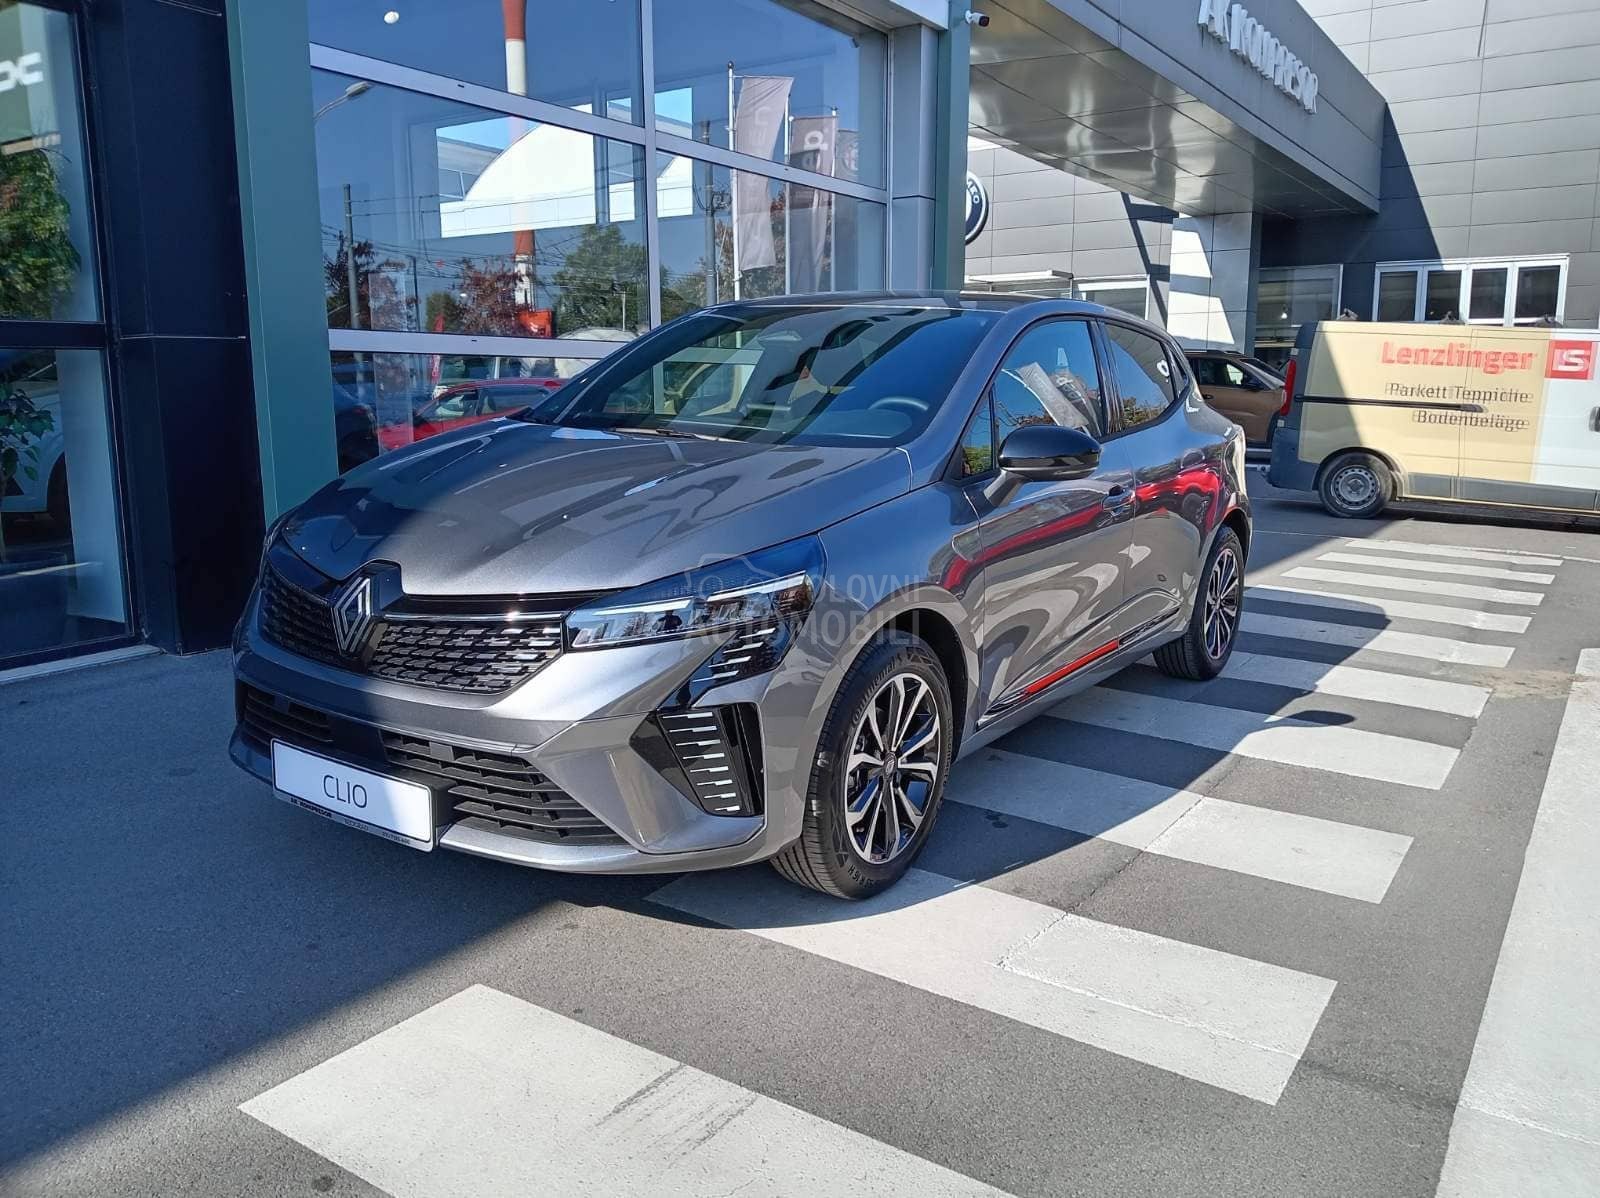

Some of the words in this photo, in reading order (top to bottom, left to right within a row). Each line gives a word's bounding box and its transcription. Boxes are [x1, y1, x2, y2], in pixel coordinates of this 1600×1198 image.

[1381, 341, 1534, 375] Lenzlinger
[1386, 382, 1448, 399] Parkett
[1413, 410, 1529, 432] Bodenbeläge
[323, 774, 368, 809] CLIO
